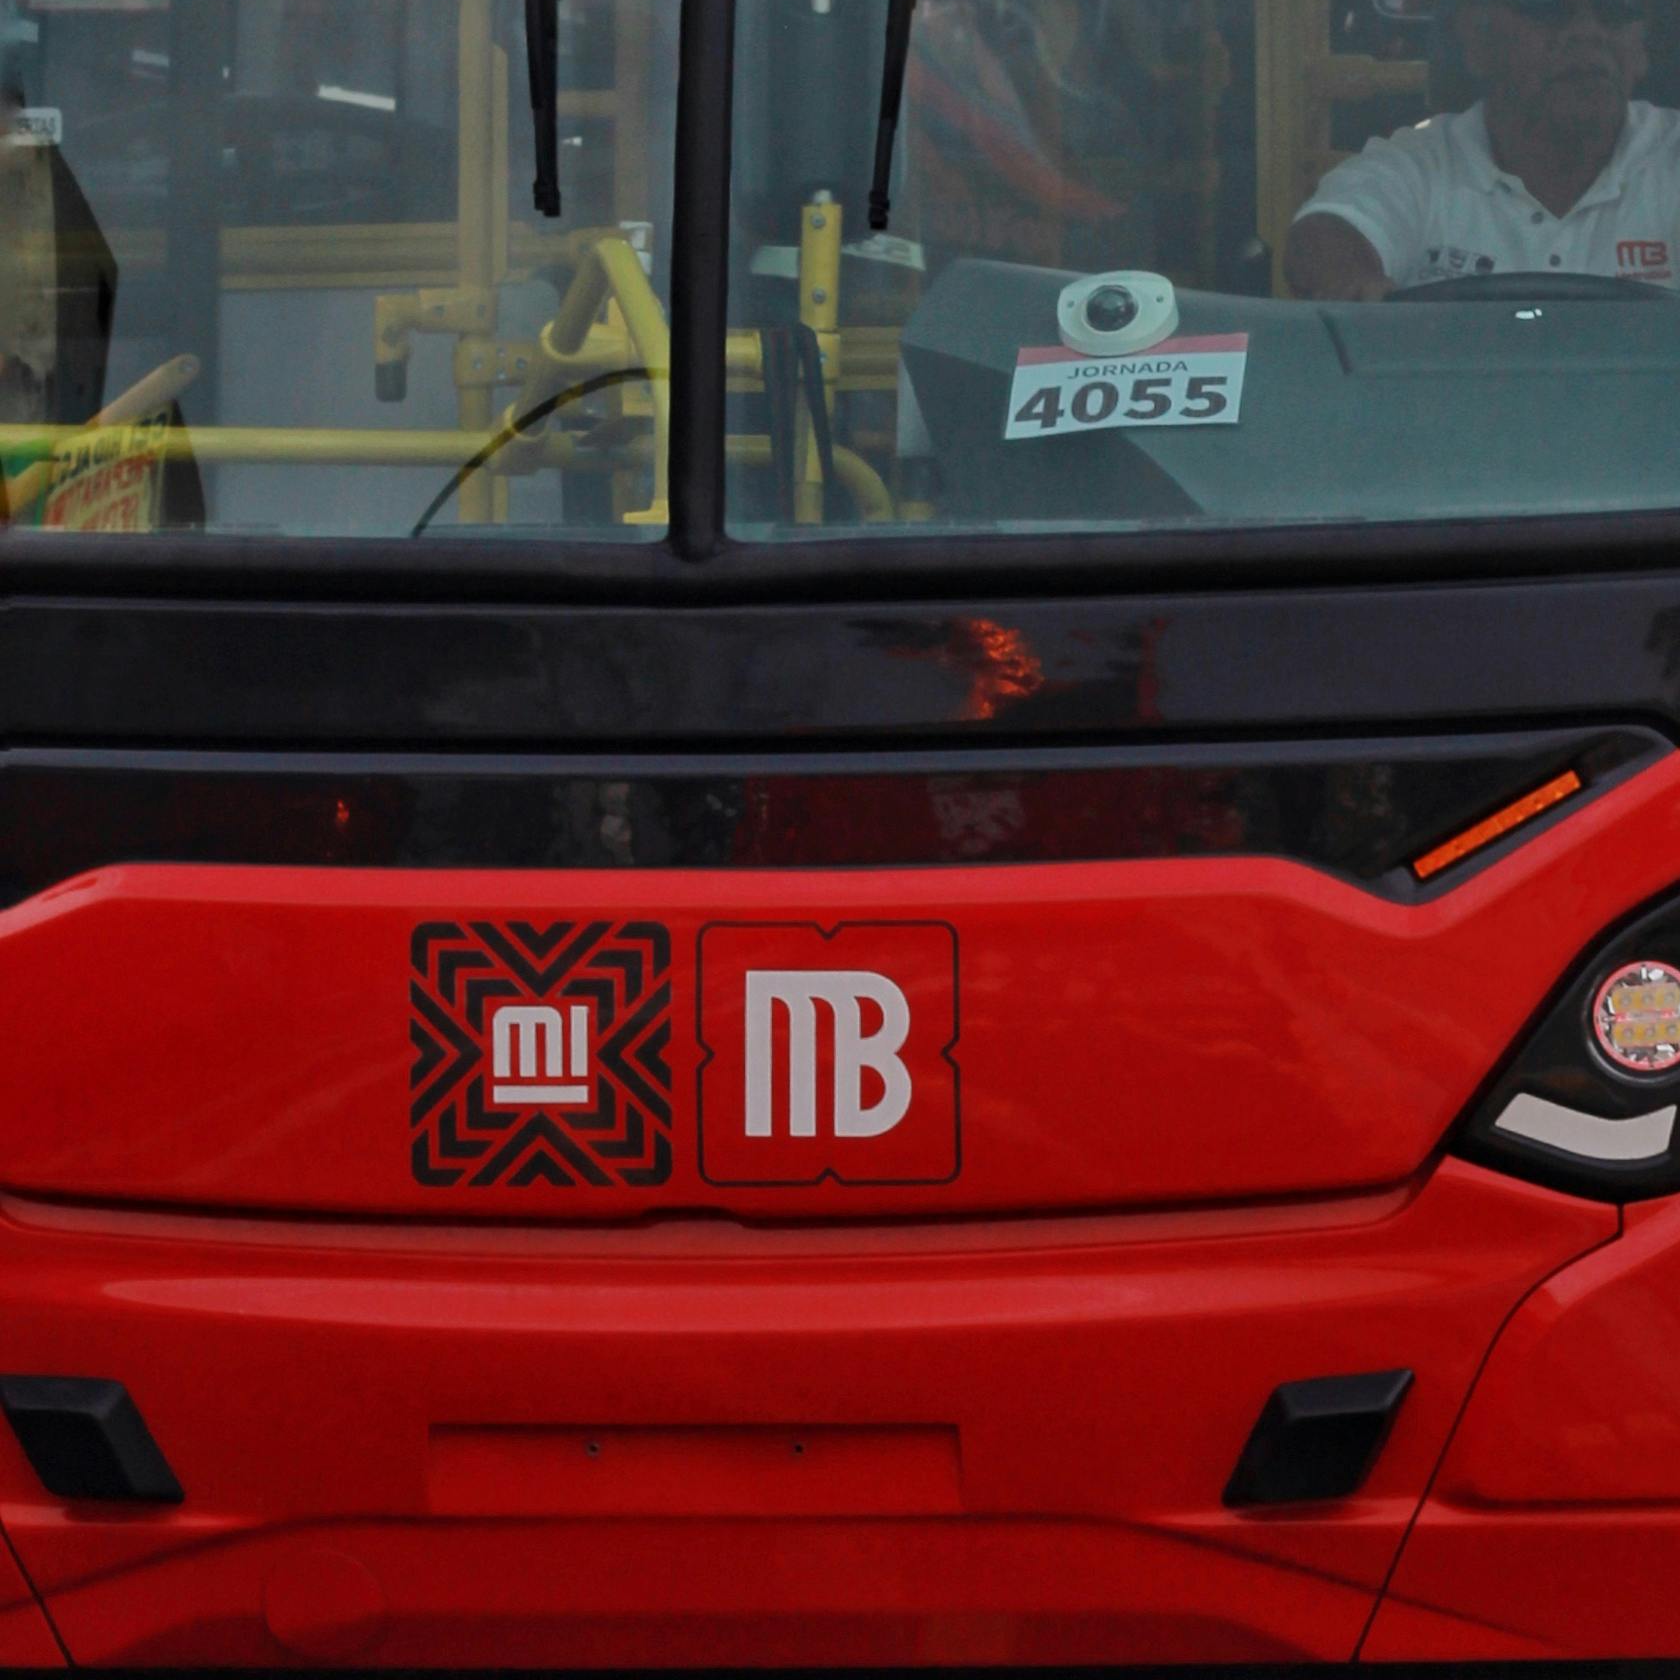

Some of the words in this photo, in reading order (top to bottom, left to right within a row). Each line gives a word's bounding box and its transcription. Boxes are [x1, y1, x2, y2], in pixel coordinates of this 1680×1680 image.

[1067, 360, 1189, 380] JORNADA
[1014, 376, 1228, 429] 4055
[745, 970, 912, 1138] MB
